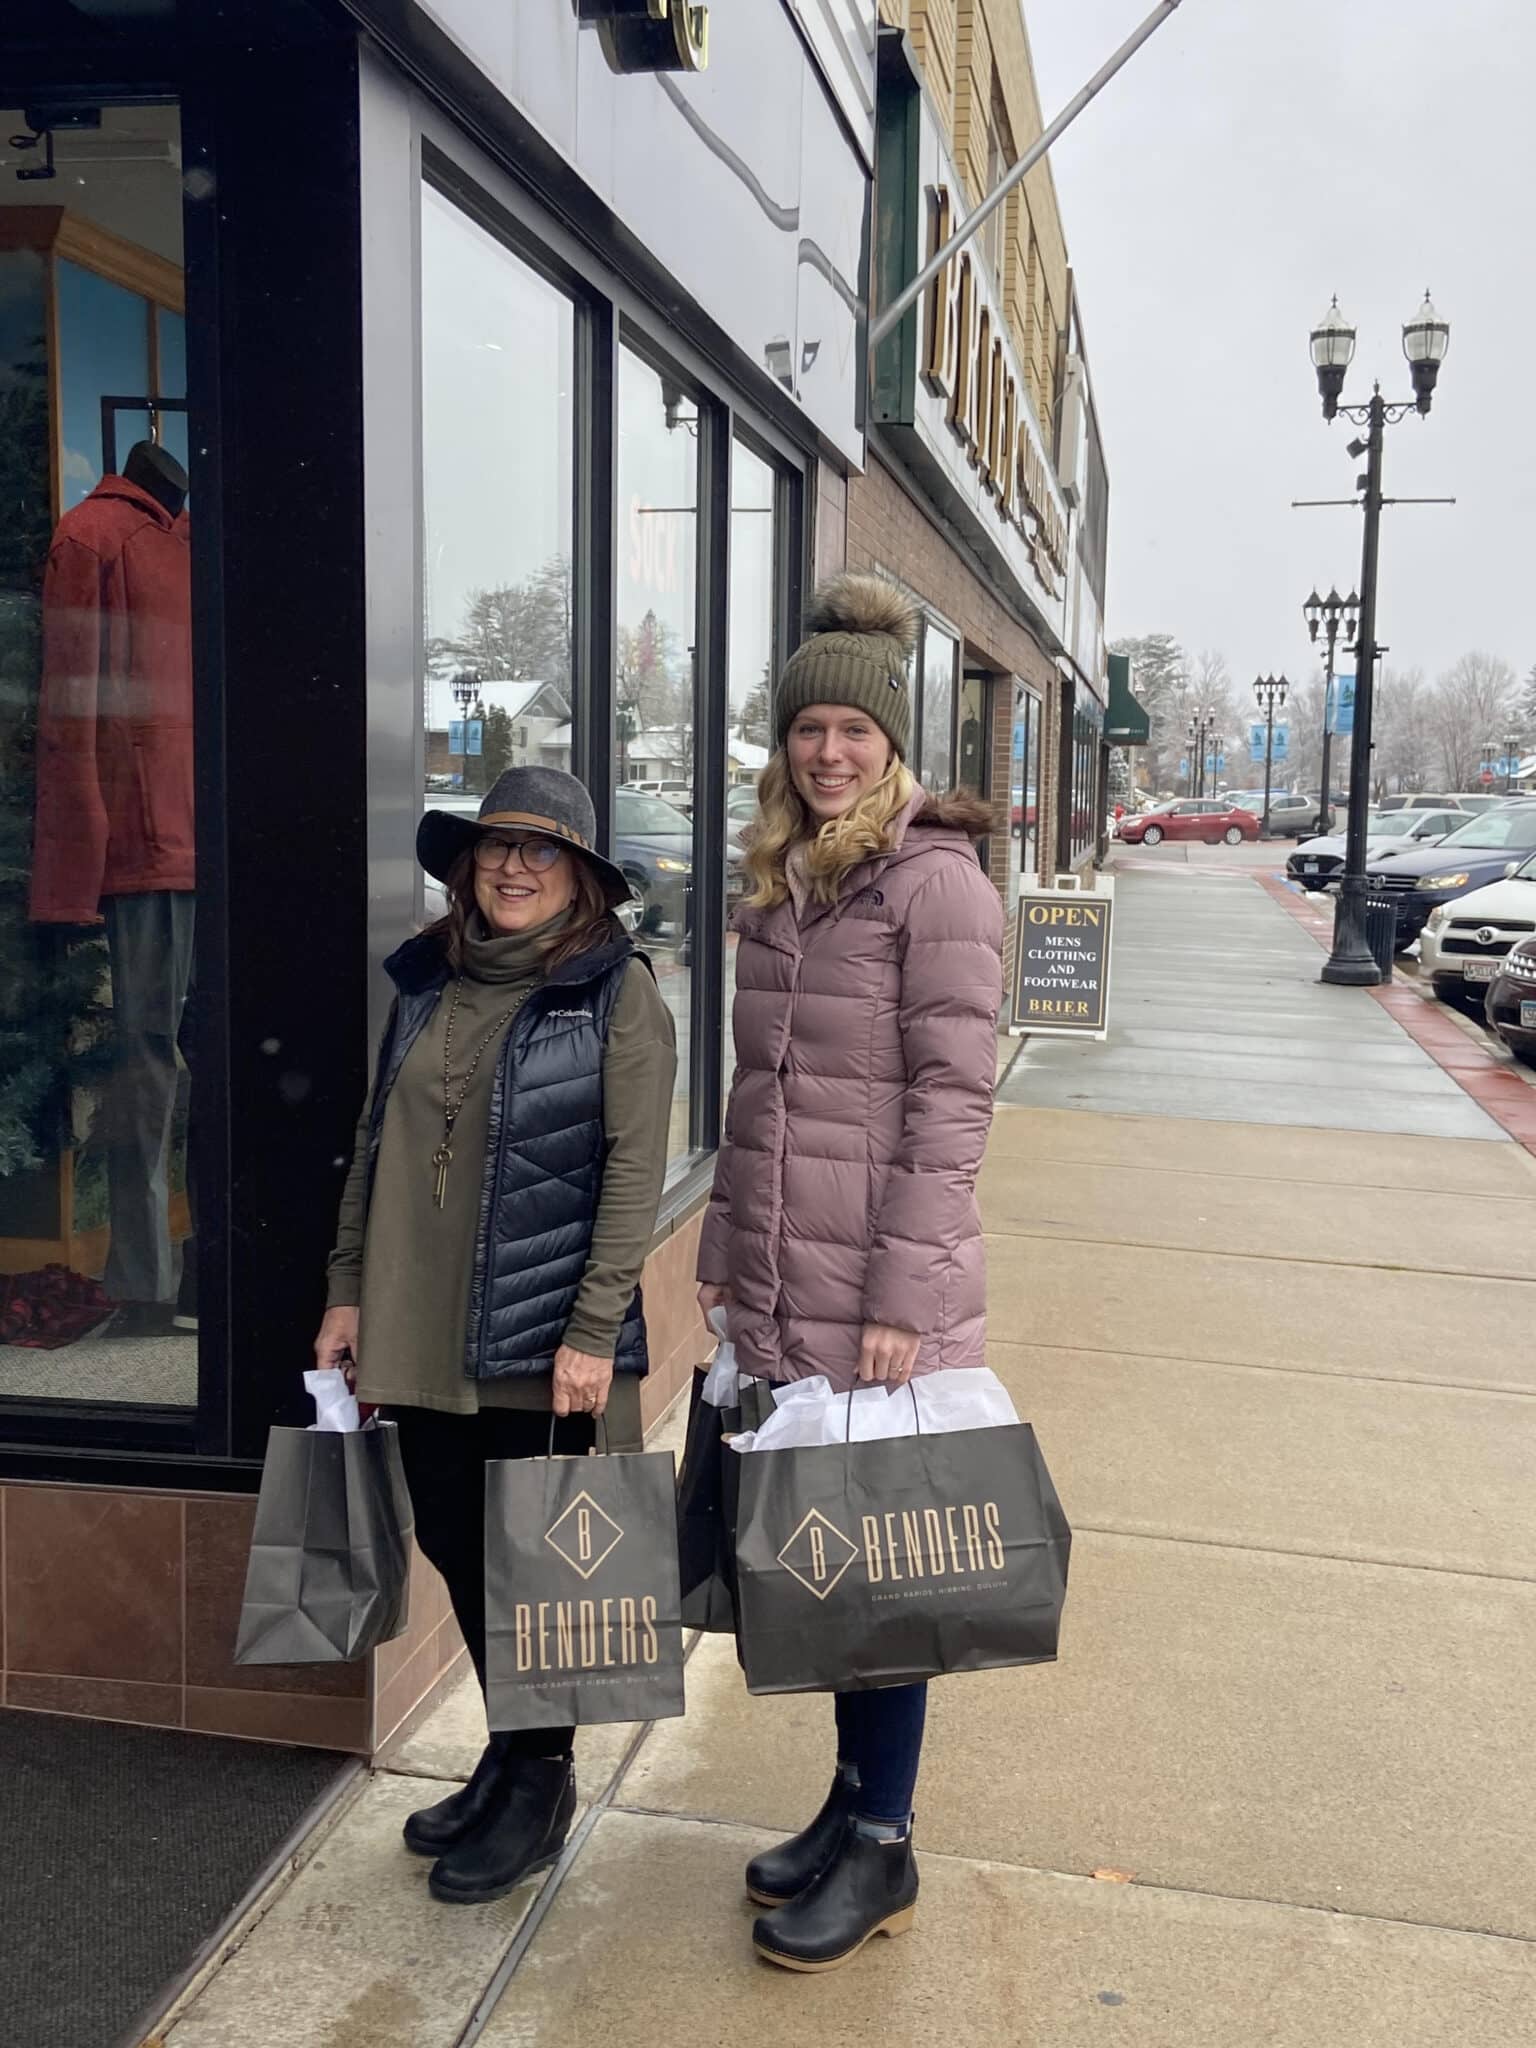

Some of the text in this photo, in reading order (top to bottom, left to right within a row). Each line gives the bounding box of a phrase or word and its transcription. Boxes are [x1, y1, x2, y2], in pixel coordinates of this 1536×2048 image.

[1029, 906, 1100, 927] OPEN
[1045, 936, 1081, 947] MENS
[1028, 949, 1096, 962] CLOTHING
[1048, 965, 1075, 974] AND
[1024, 977, 1097, 990] FOOTWEAR
[1029, 999, 1088, 1013] BRIER
[577, 1508, 592, 1561] B
[862, 1502, 1005, 1583] BENDERS
[810, 1526, 827, 1581] B
[515, 1596, 658, 1672] BENDERS
